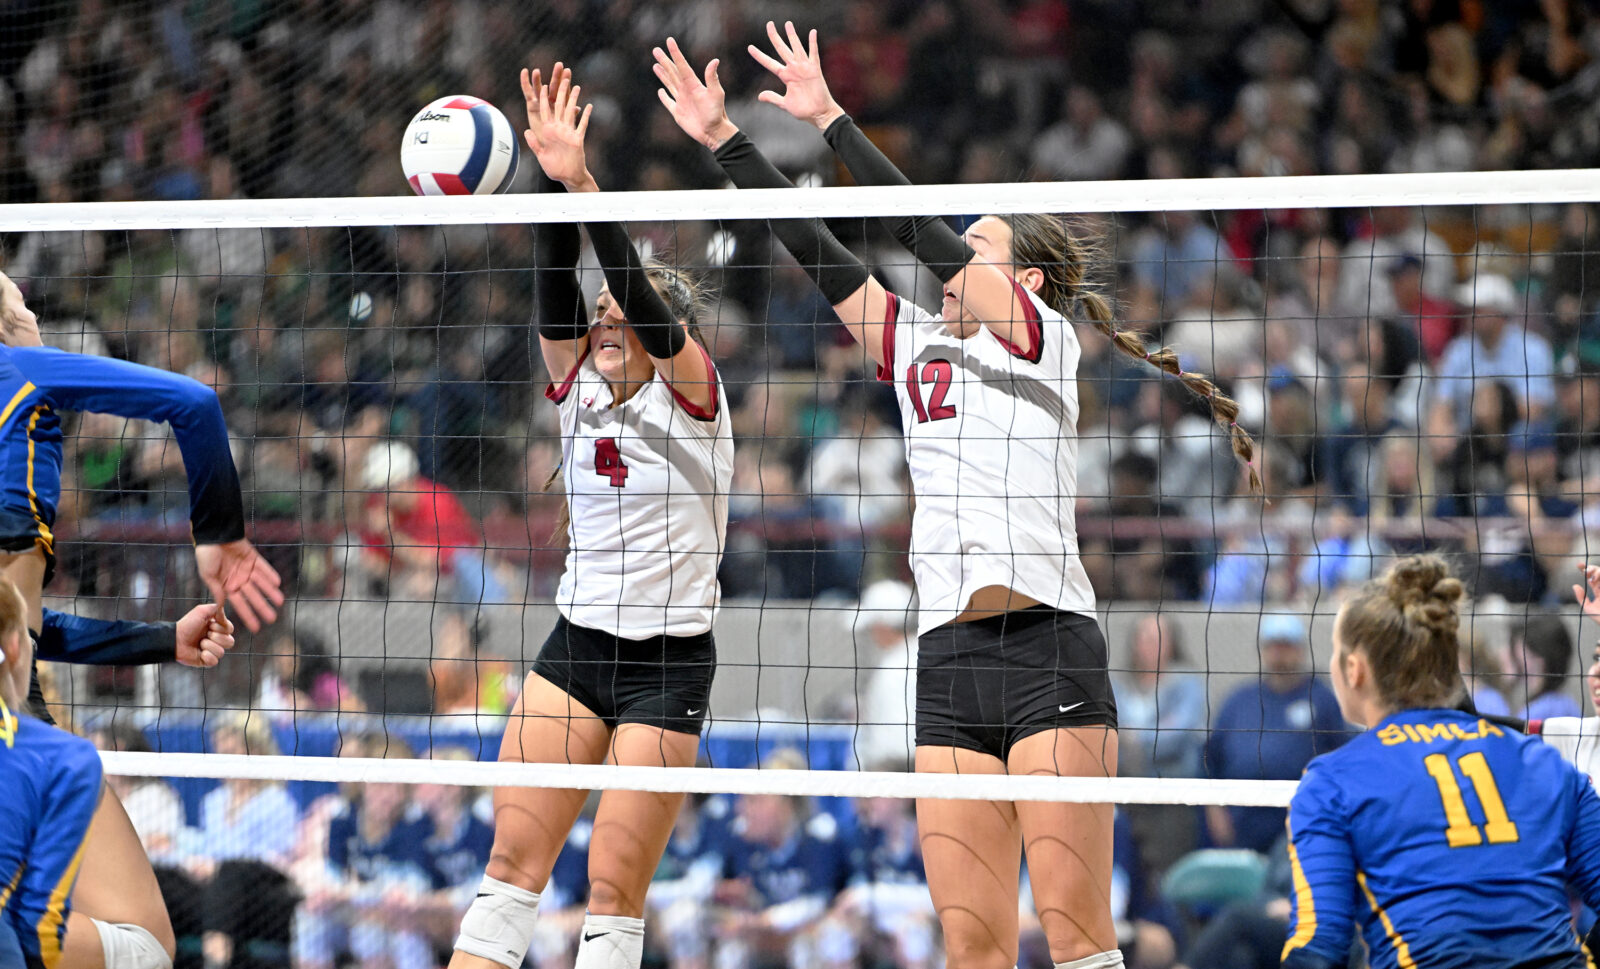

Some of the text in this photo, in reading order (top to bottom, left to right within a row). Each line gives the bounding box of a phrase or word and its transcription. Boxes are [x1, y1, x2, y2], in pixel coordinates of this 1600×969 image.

[906, 358, 957, 424] 12
[594, 437, 629, 488] 4
[1377, 718, 1504, 746] SIMLA
[1424, 751, 1519, 848] 11
